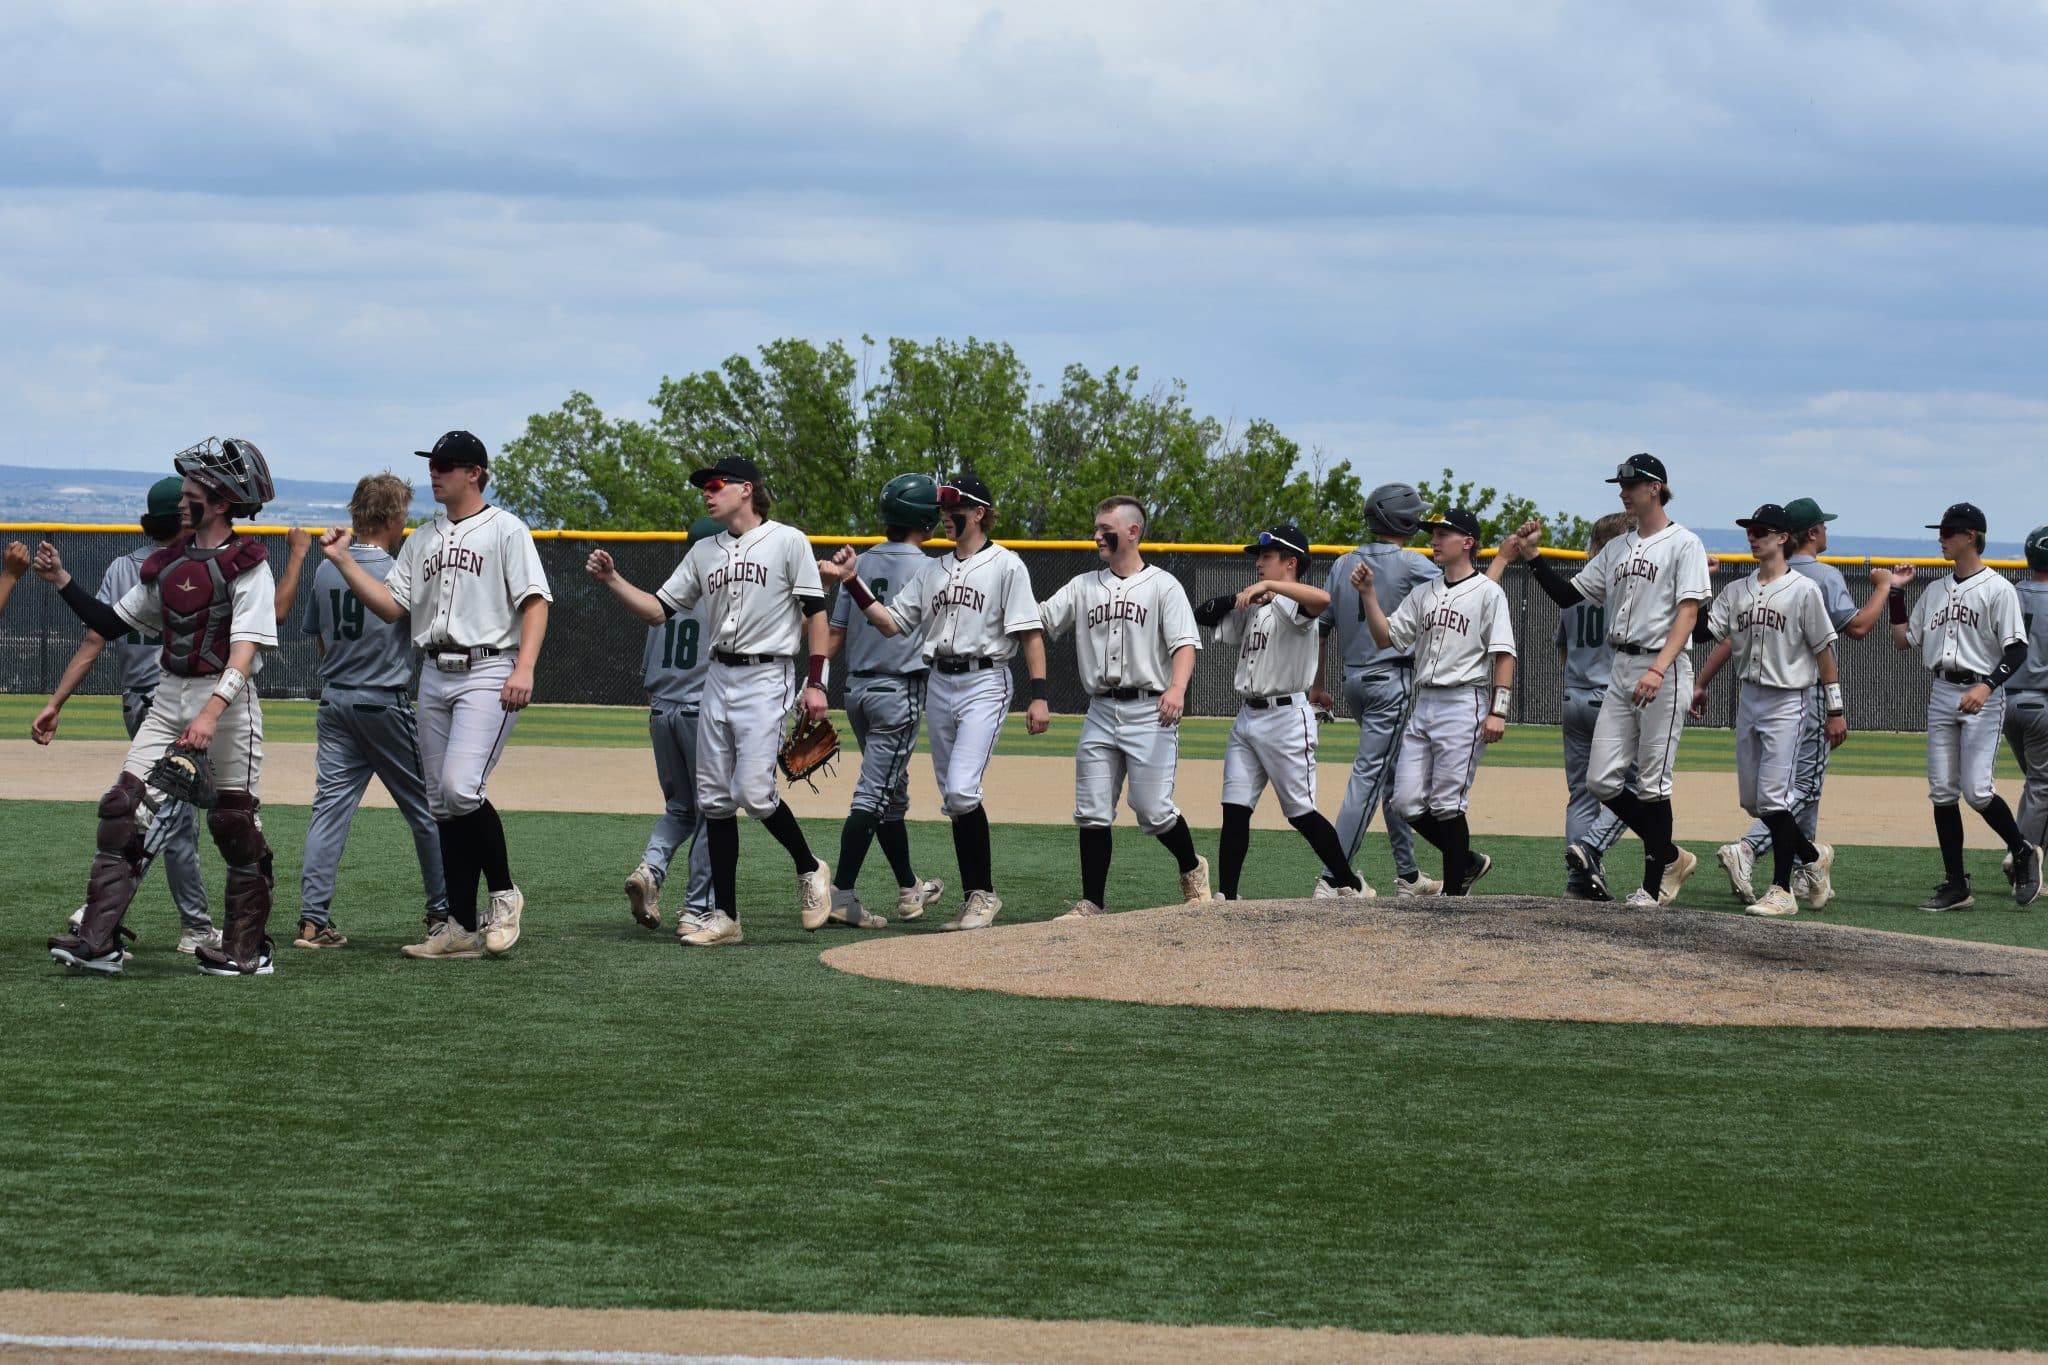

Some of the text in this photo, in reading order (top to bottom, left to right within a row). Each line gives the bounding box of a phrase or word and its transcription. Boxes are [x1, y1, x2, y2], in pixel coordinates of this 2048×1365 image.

[423, 548, 483, 582] GOLDEN
[708, 562, 768, 594] GOLDEN
[329, 589, 365, 640] 19
[932, 586, 985, 616] GOLDEN
[1087, 601, 1147, 628] GOLDEN
[1930, 604, 1979, 630] GOLDEN
[1576, 604, 1604, 648] 10
[1737, 608, 1786, 633] GOLDEN
[662, 618, 700, 669] 18
